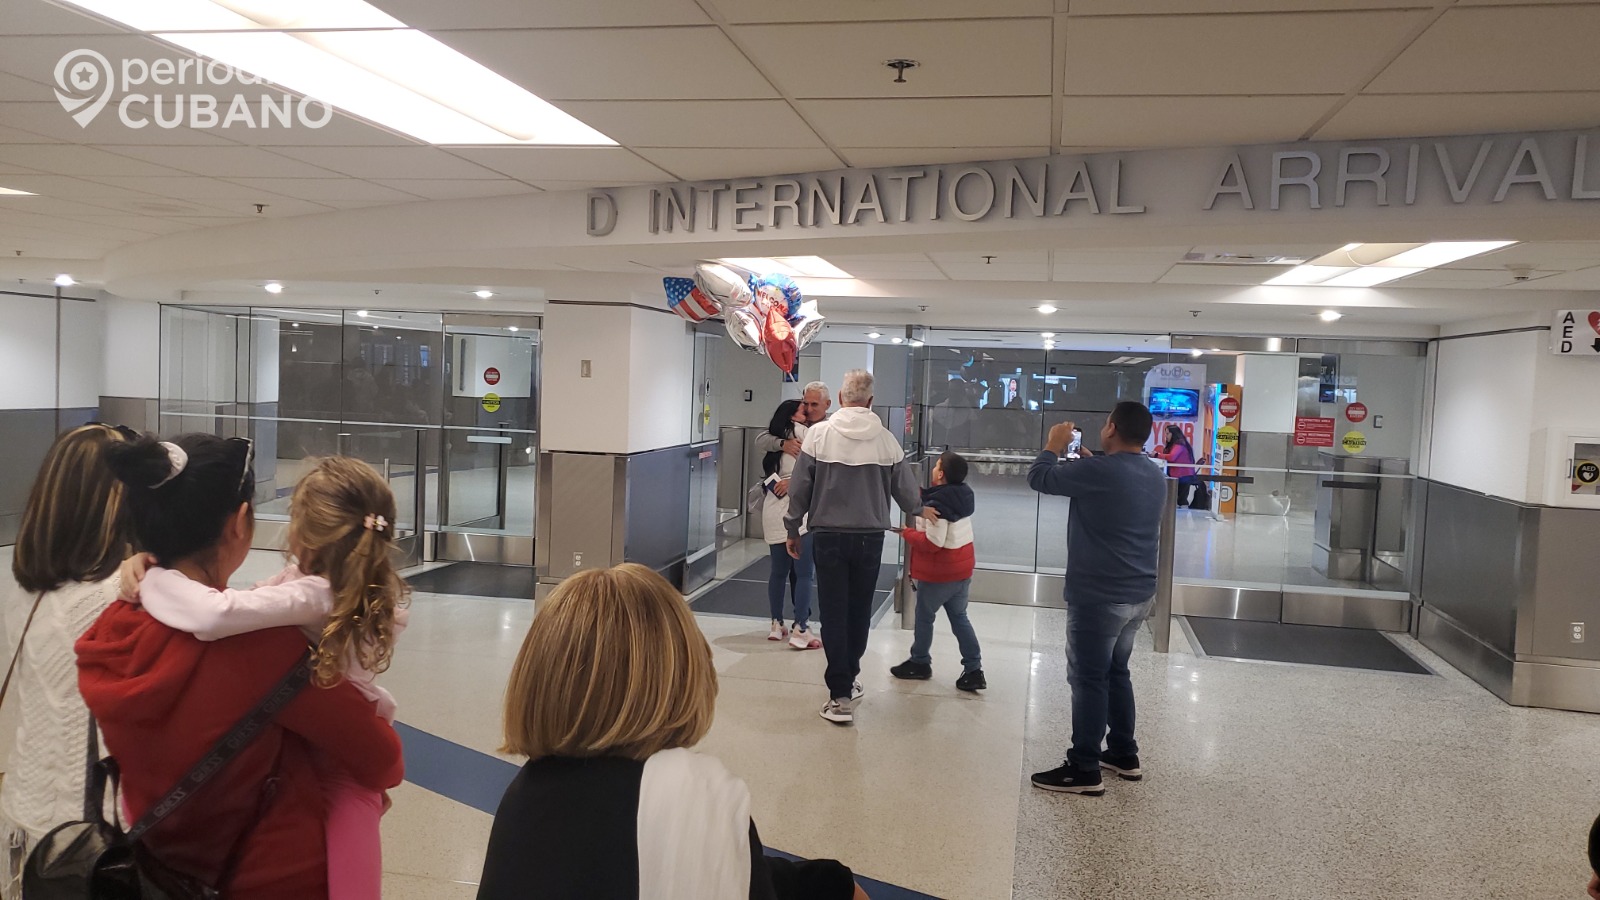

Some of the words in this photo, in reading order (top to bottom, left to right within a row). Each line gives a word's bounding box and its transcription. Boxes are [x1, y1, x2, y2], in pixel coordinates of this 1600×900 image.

[586, 192, 619, 237] D
[648, 158, 1147, 236] INTERNATIONAL
[1202, 134, 1600, 211] ARRIVAL
